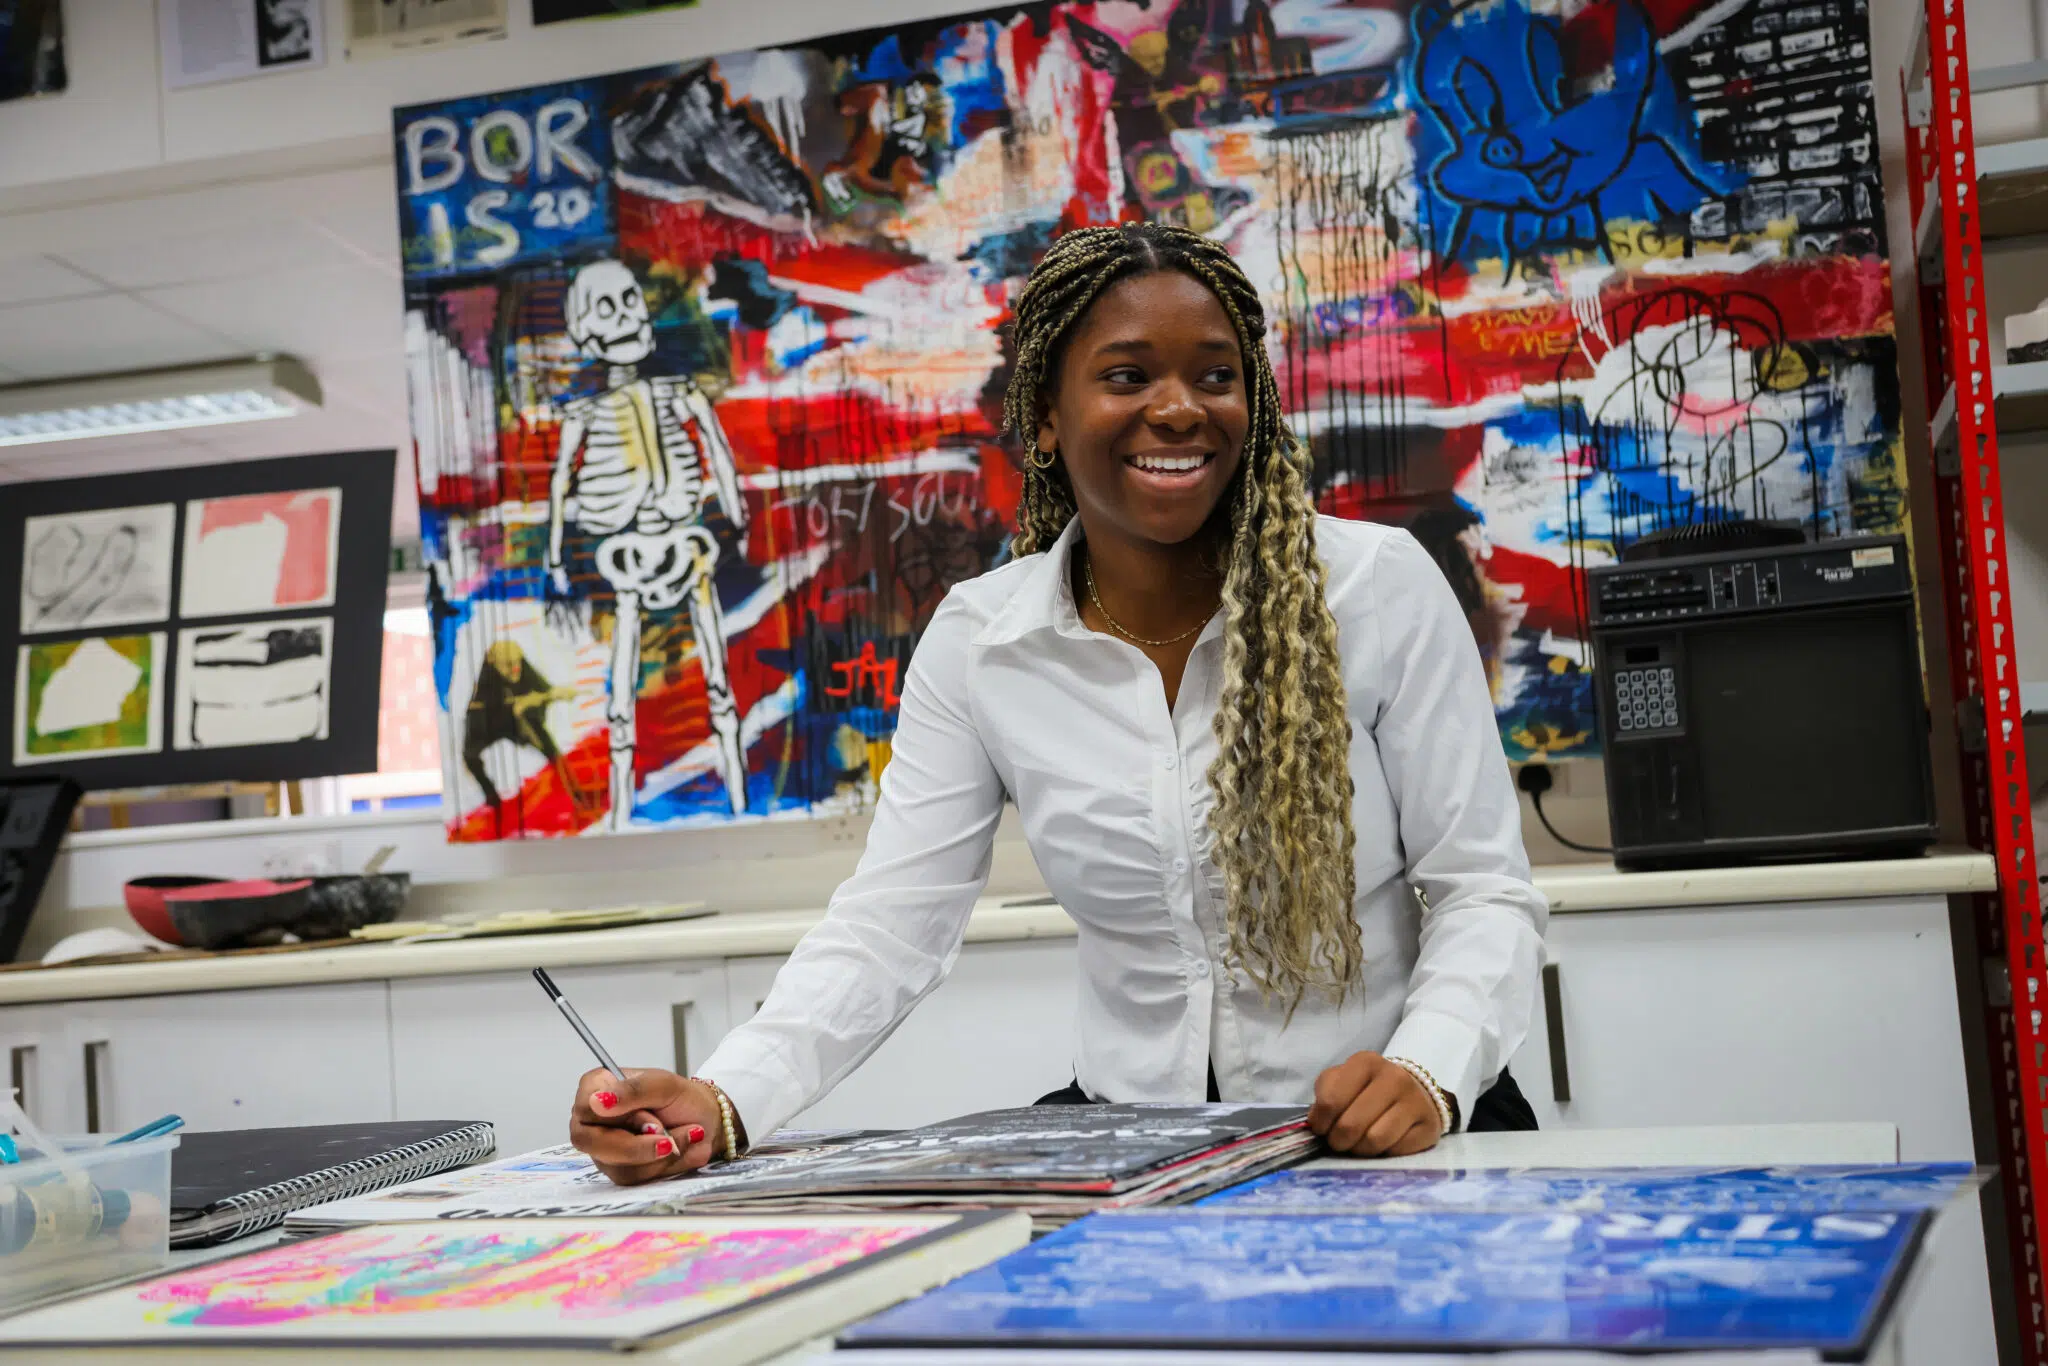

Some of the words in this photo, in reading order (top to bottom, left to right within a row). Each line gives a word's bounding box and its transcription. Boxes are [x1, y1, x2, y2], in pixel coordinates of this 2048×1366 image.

[402, 98, 602, 195] BOR
[427, 189, 521, 266] IS
[528, 188, 592, 230] 20
